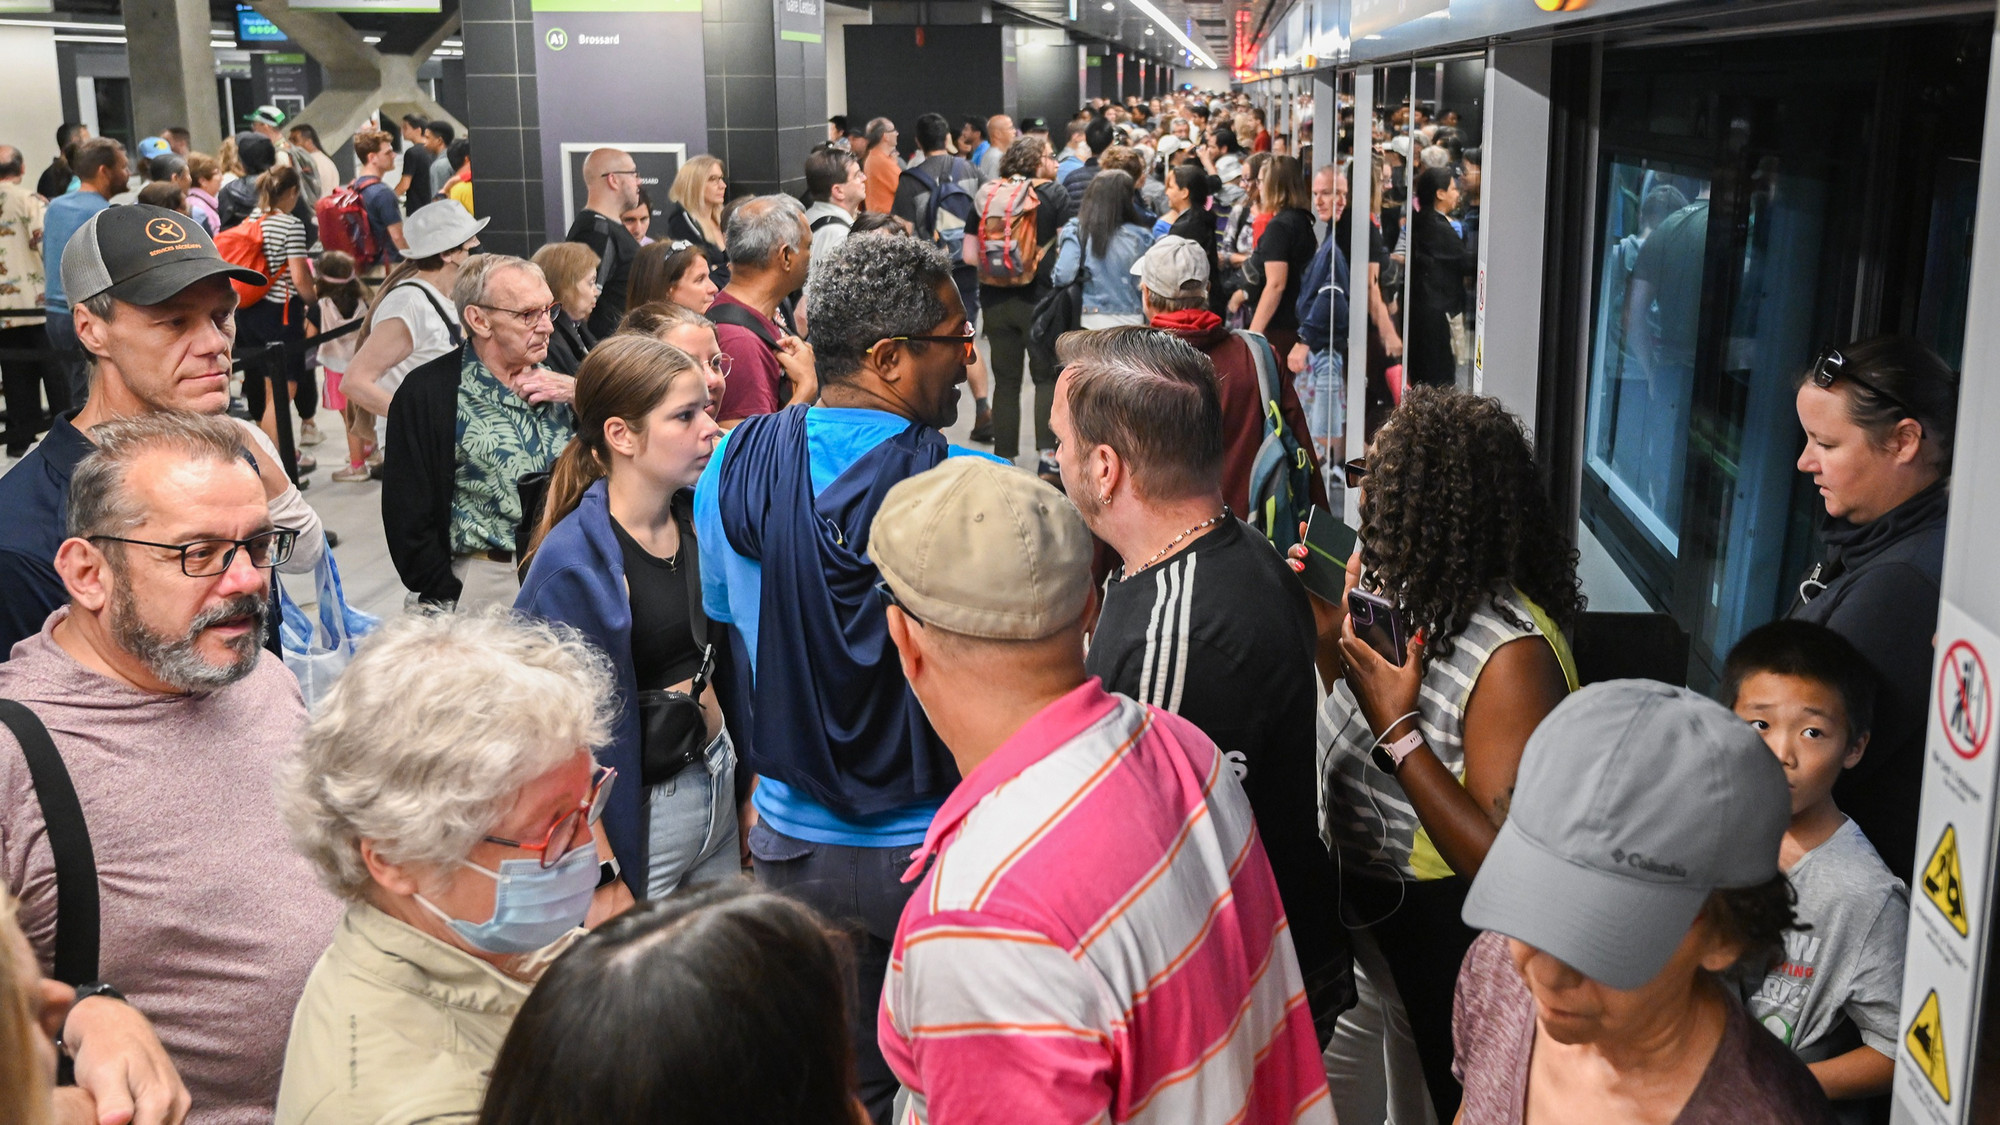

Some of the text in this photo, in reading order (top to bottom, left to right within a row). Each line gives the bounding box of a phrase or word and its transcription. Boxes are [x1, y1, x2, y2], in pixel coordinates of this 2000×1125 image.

[550, 33, 620, 45] A1 Brossard
[642, 177, 659, 185] SSARD
[1627, 852, 1687, 877] Columbia
